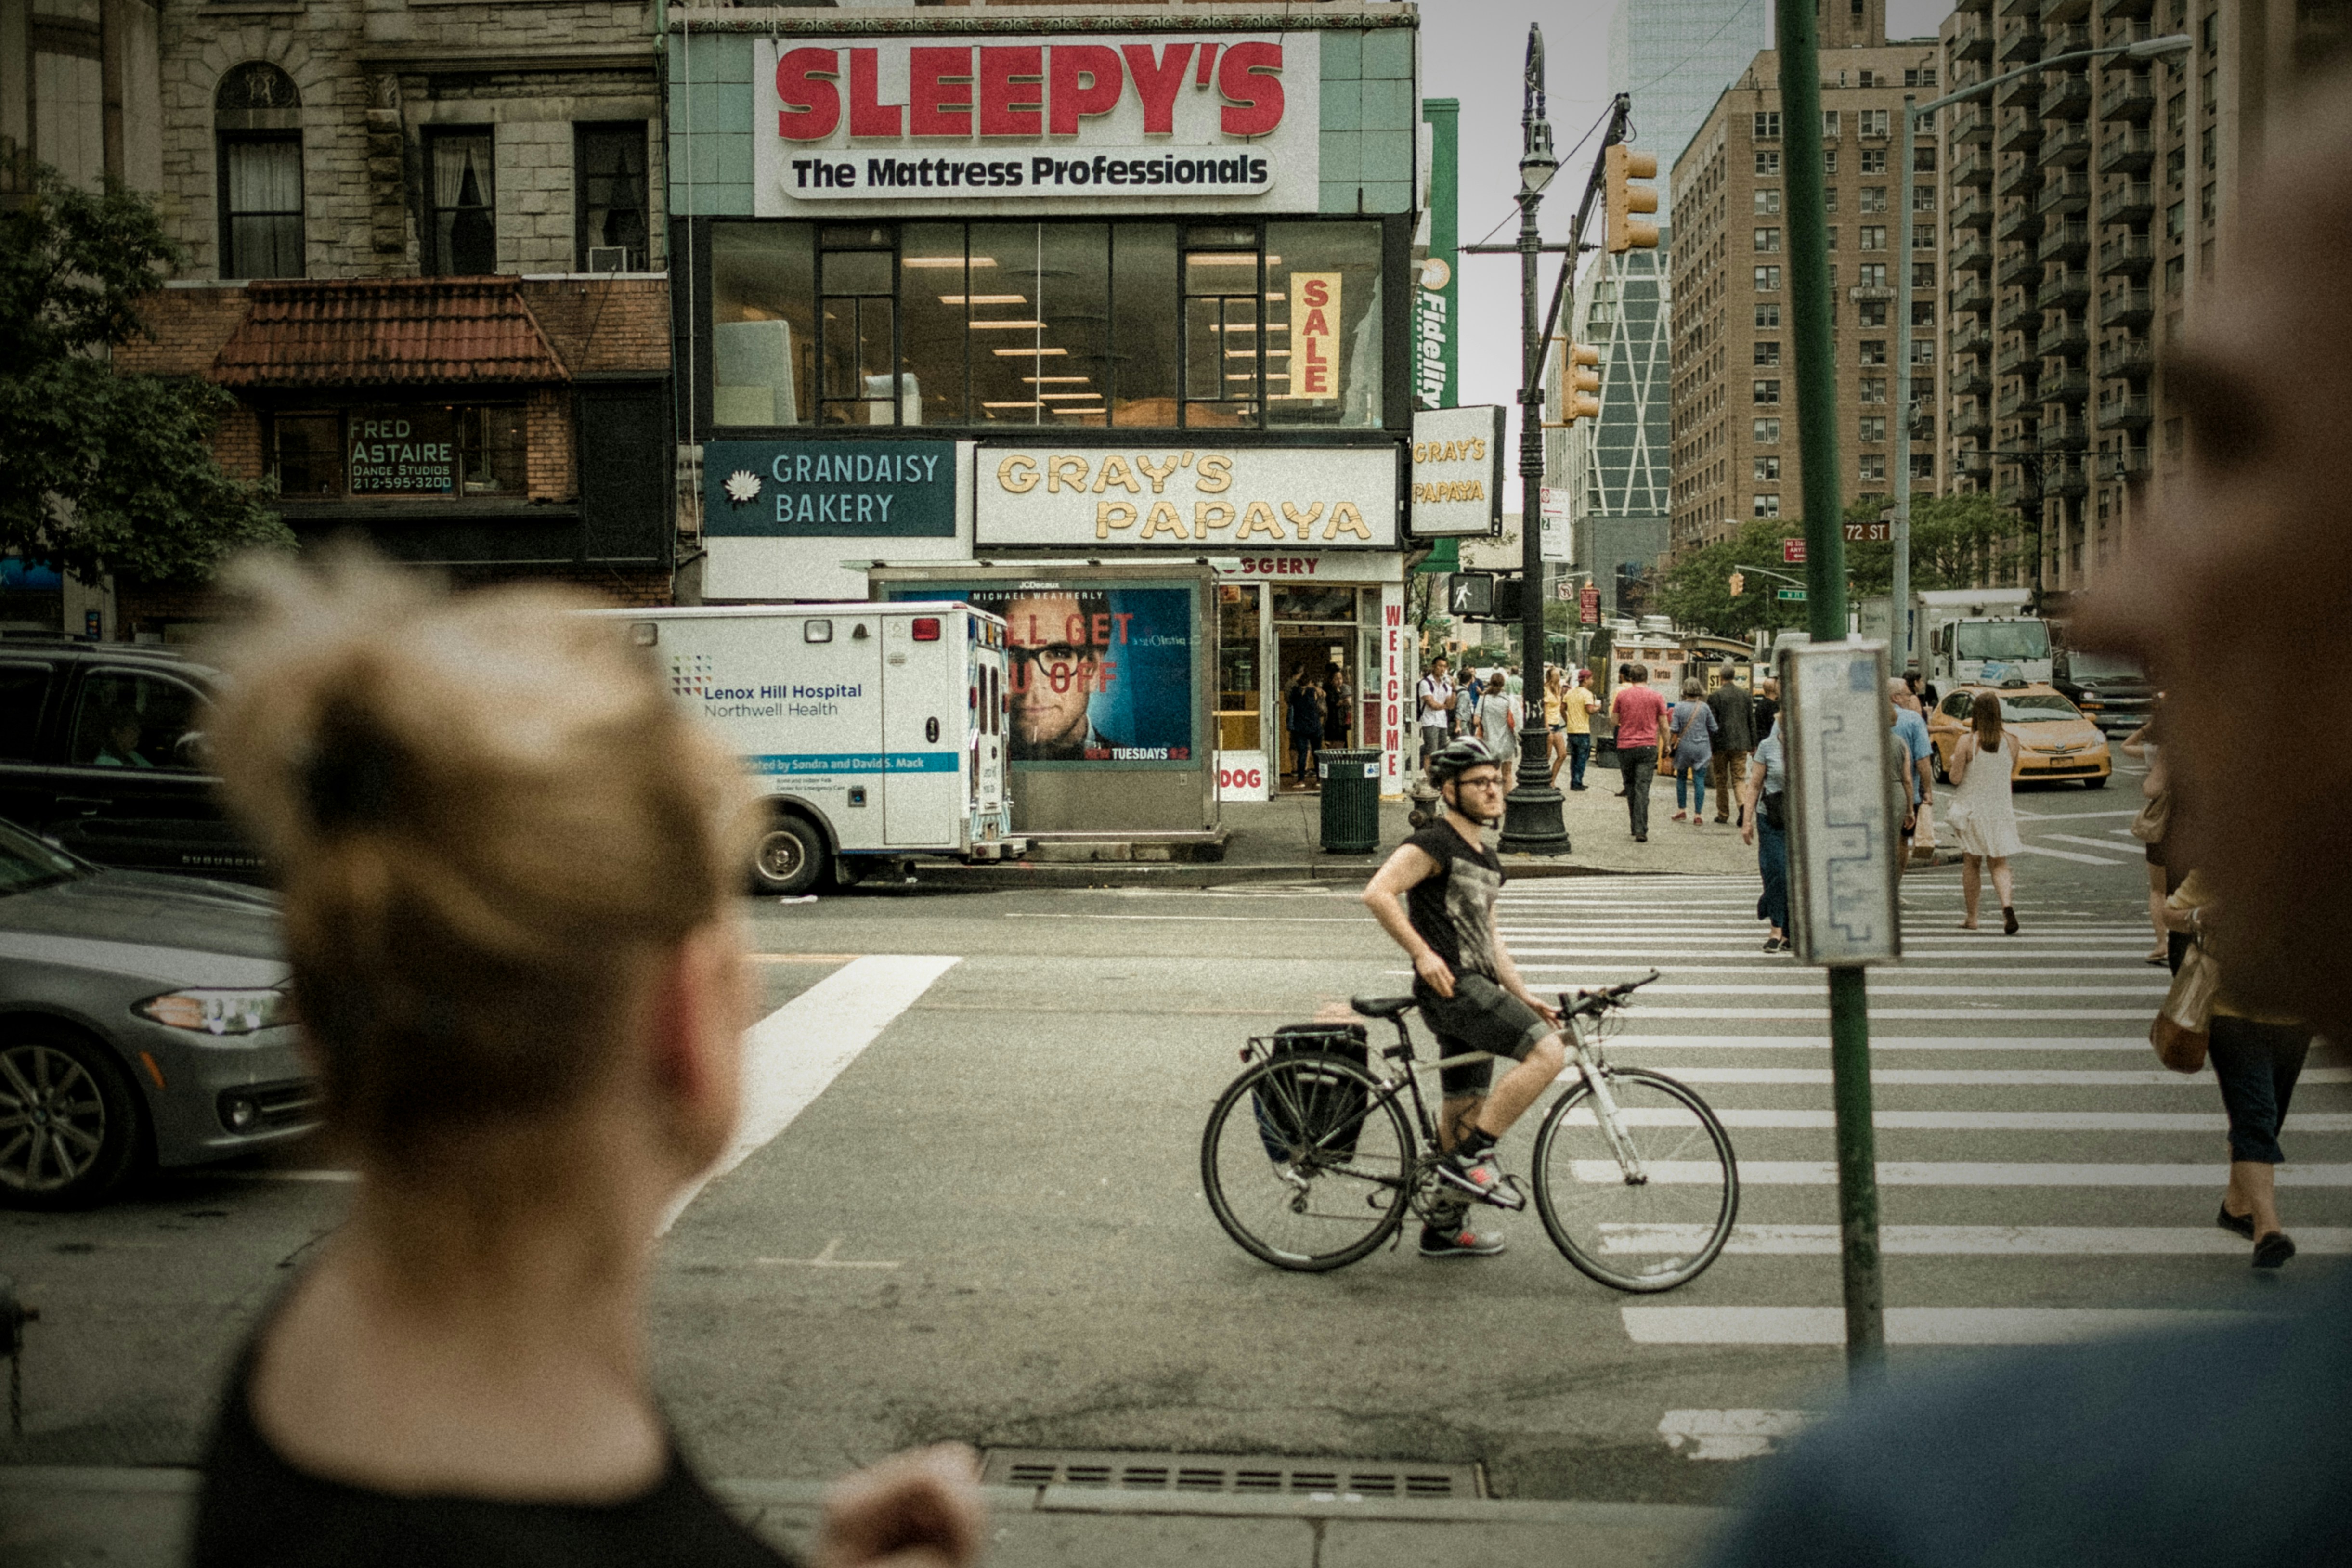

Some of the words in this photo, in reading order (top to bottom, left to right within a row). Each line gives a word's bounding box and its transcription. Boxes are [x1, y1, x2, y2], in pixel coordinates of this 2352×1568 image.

[775, 41, 1285, 142] SLEEPY'S
[792, 158, 855, 188] The
[867, 156, 1023, 187] Mattress
[1031, 154, 1268, 186] Professionals
[1302, 280, 1329, 392] SALE
[1418, 292, 1446, 409] Fidelity
[350, 419, 410, 439] FRED
[352, 441, 452, 463] ASTAIRE
[1413, 437, 1485, 463] GRAY'S
[353, 465, 392, 476] DANCE
[398, 465, 450, 476] STUDIOS
[771, 455, 939, 484] GRANDAISY
[997, 450, 1232, 493] GRAY'S
[1412, 479, 1484, 503] PAPAYA
[776, 493, 893, 524] BAKERY
[1095, 501, 1372, 540] PAPAYA
[1845, 525, 1863, 539] 72
[1870, 525, 1885, 539] ST
[1223, 557, 1319, 574] GGERY
[973, 592, 1025, 600] MICHAEL
[1034, 591, 1104, 600] WEATHERLY
[1019, 581, 1059, 589] JCDecaux
[1066, 613, 1134, 645] GET
[1616, 649, 1633, 659] Tacos
[1050, 662, 1117, 694] OFF
[1654, 669, 1670, 679] Tortas
[705, 687, 754, 700] Lenox
[761, 686, 786, 698] Hill
[793, 684, 862, 700] Hospital
[1385, 605, 1401, 776] WELCOME
[704, 703, 782, 717] Northwell
[789, 703, 838, 715] Health
[1085, 748, 1110, 760] NEW
[1112, 747, 1168, 760] TUESDAYS
[778, 760, 789, 772] by
[793, 760, 828, 770] Sondra
[831, 759, 850, 769] and
[853, 758, 882, 769] David
[897, 758, 924, 768] Mack
[1220, 769, 1261, 788] DOG
